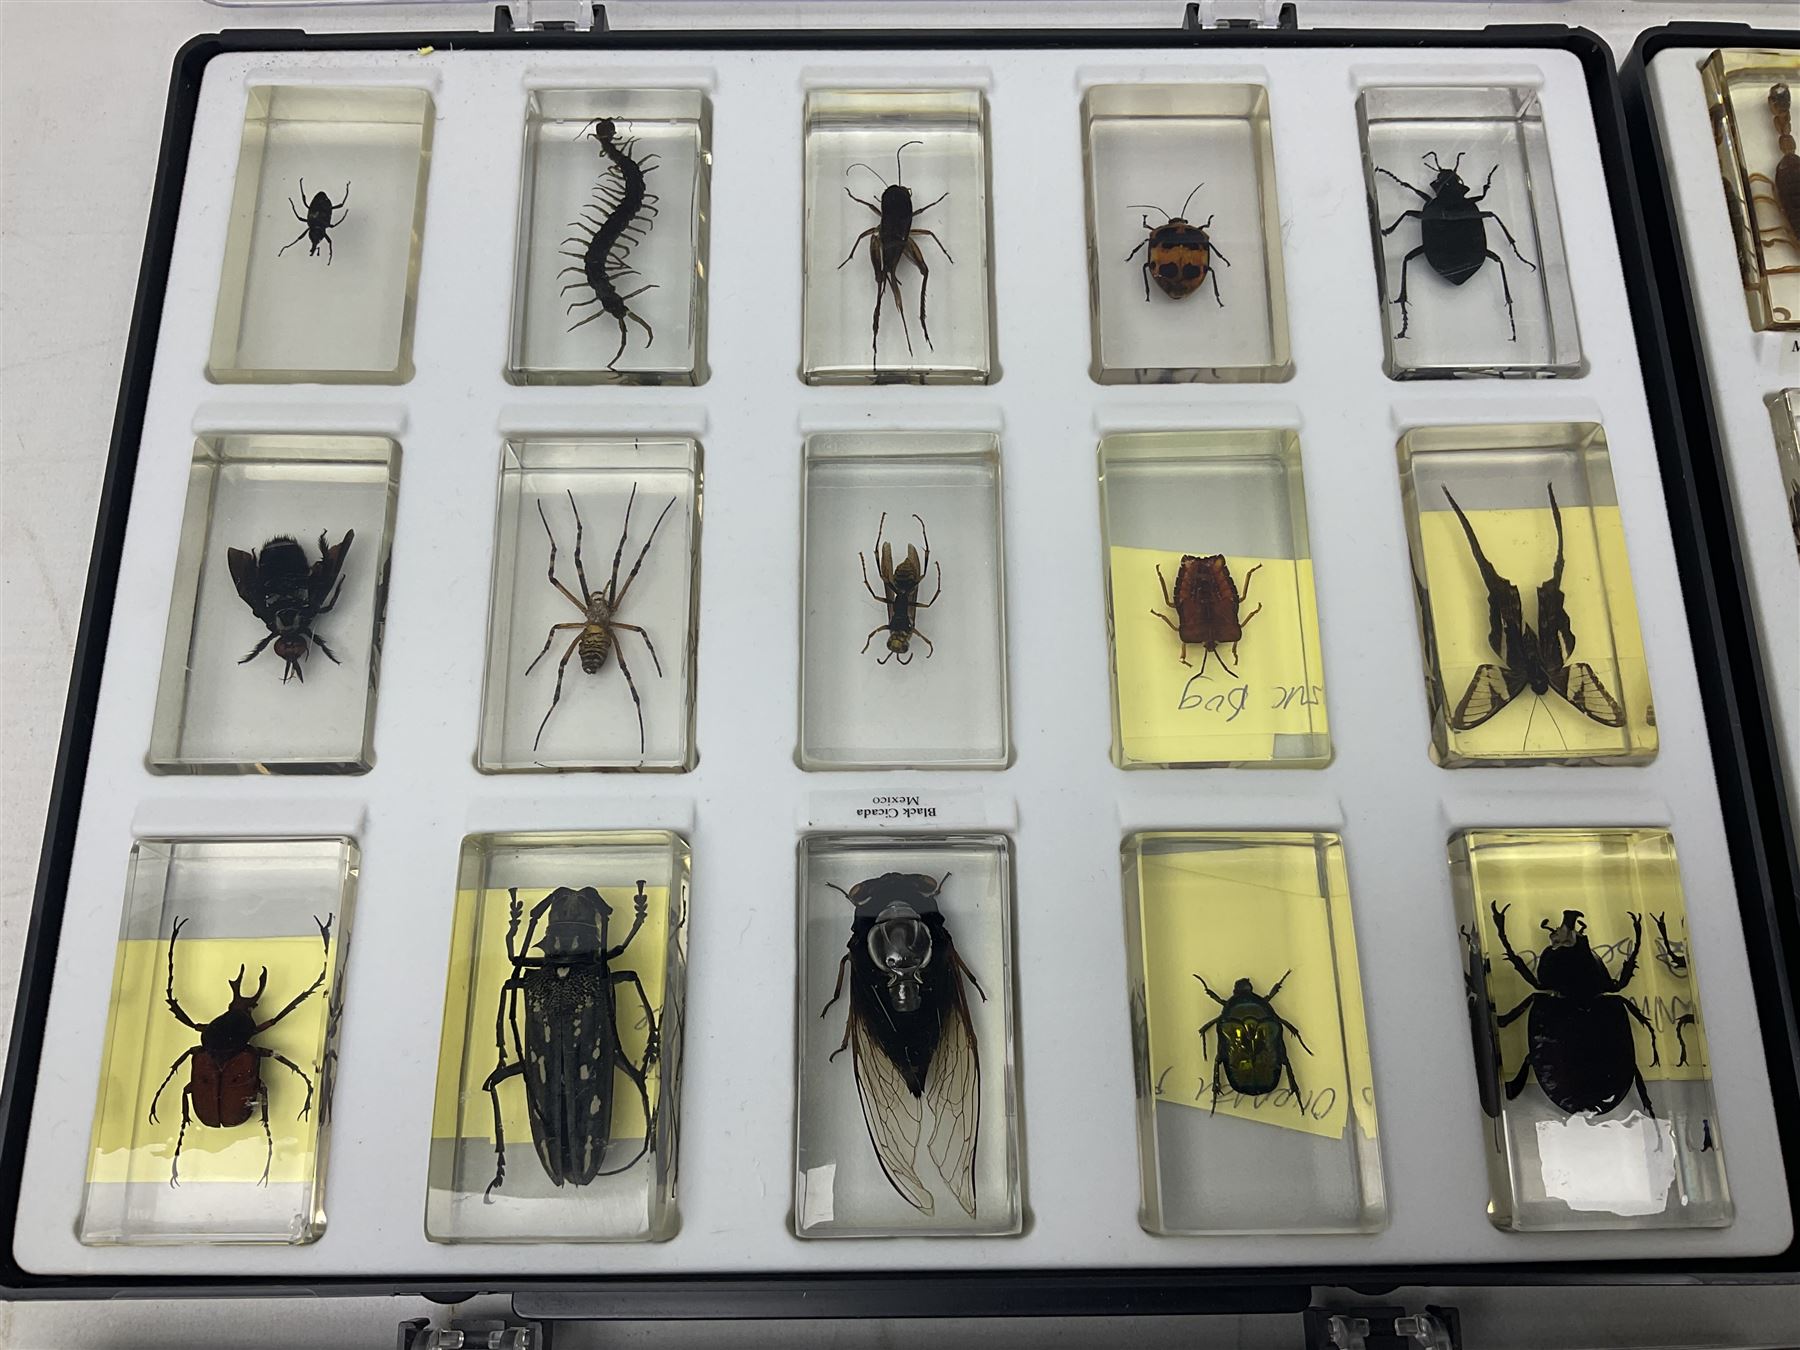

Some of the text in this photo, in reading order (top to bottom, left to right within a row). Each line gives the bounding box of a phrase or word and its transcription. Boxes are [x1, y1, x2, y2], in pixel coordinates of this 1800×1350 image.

[872, 796, 920, 806] Mexico
[856, 807, 937, 819] Black Cicada
